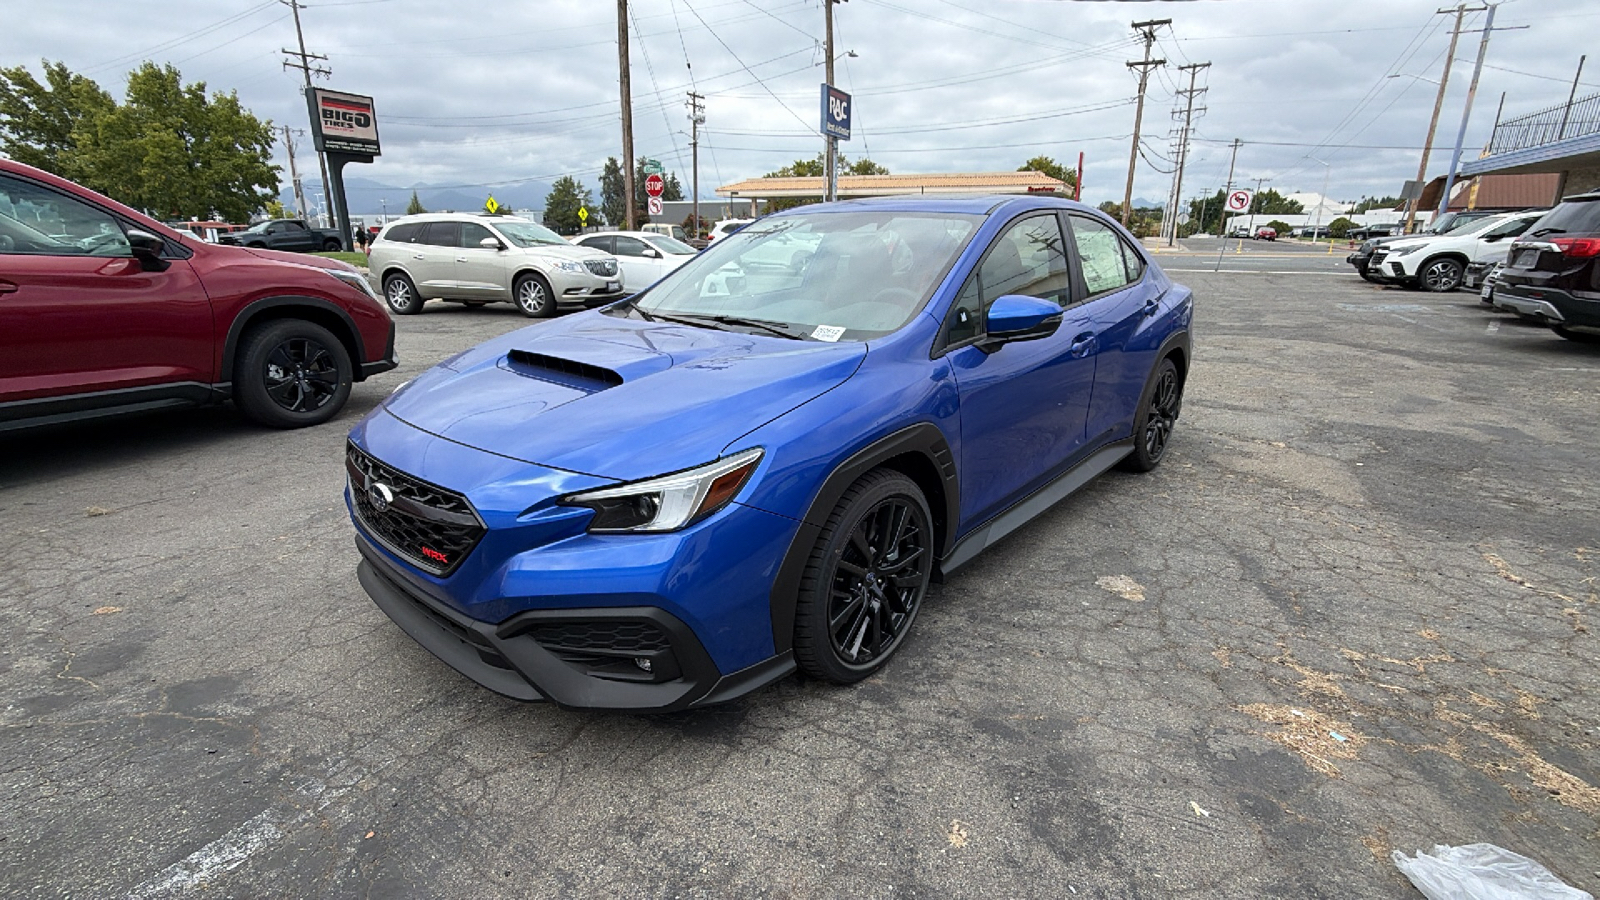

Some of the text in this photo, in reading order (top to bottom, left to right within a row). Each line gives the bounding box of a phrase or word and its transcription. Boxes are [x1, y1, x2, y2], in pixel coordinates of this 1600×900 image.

[322, 108, 354, 122] BIG
[323, 120, 355, 129] TIRES
[646, 181, 663, 191] STOP
[422, 546, 448, 563] WRX
